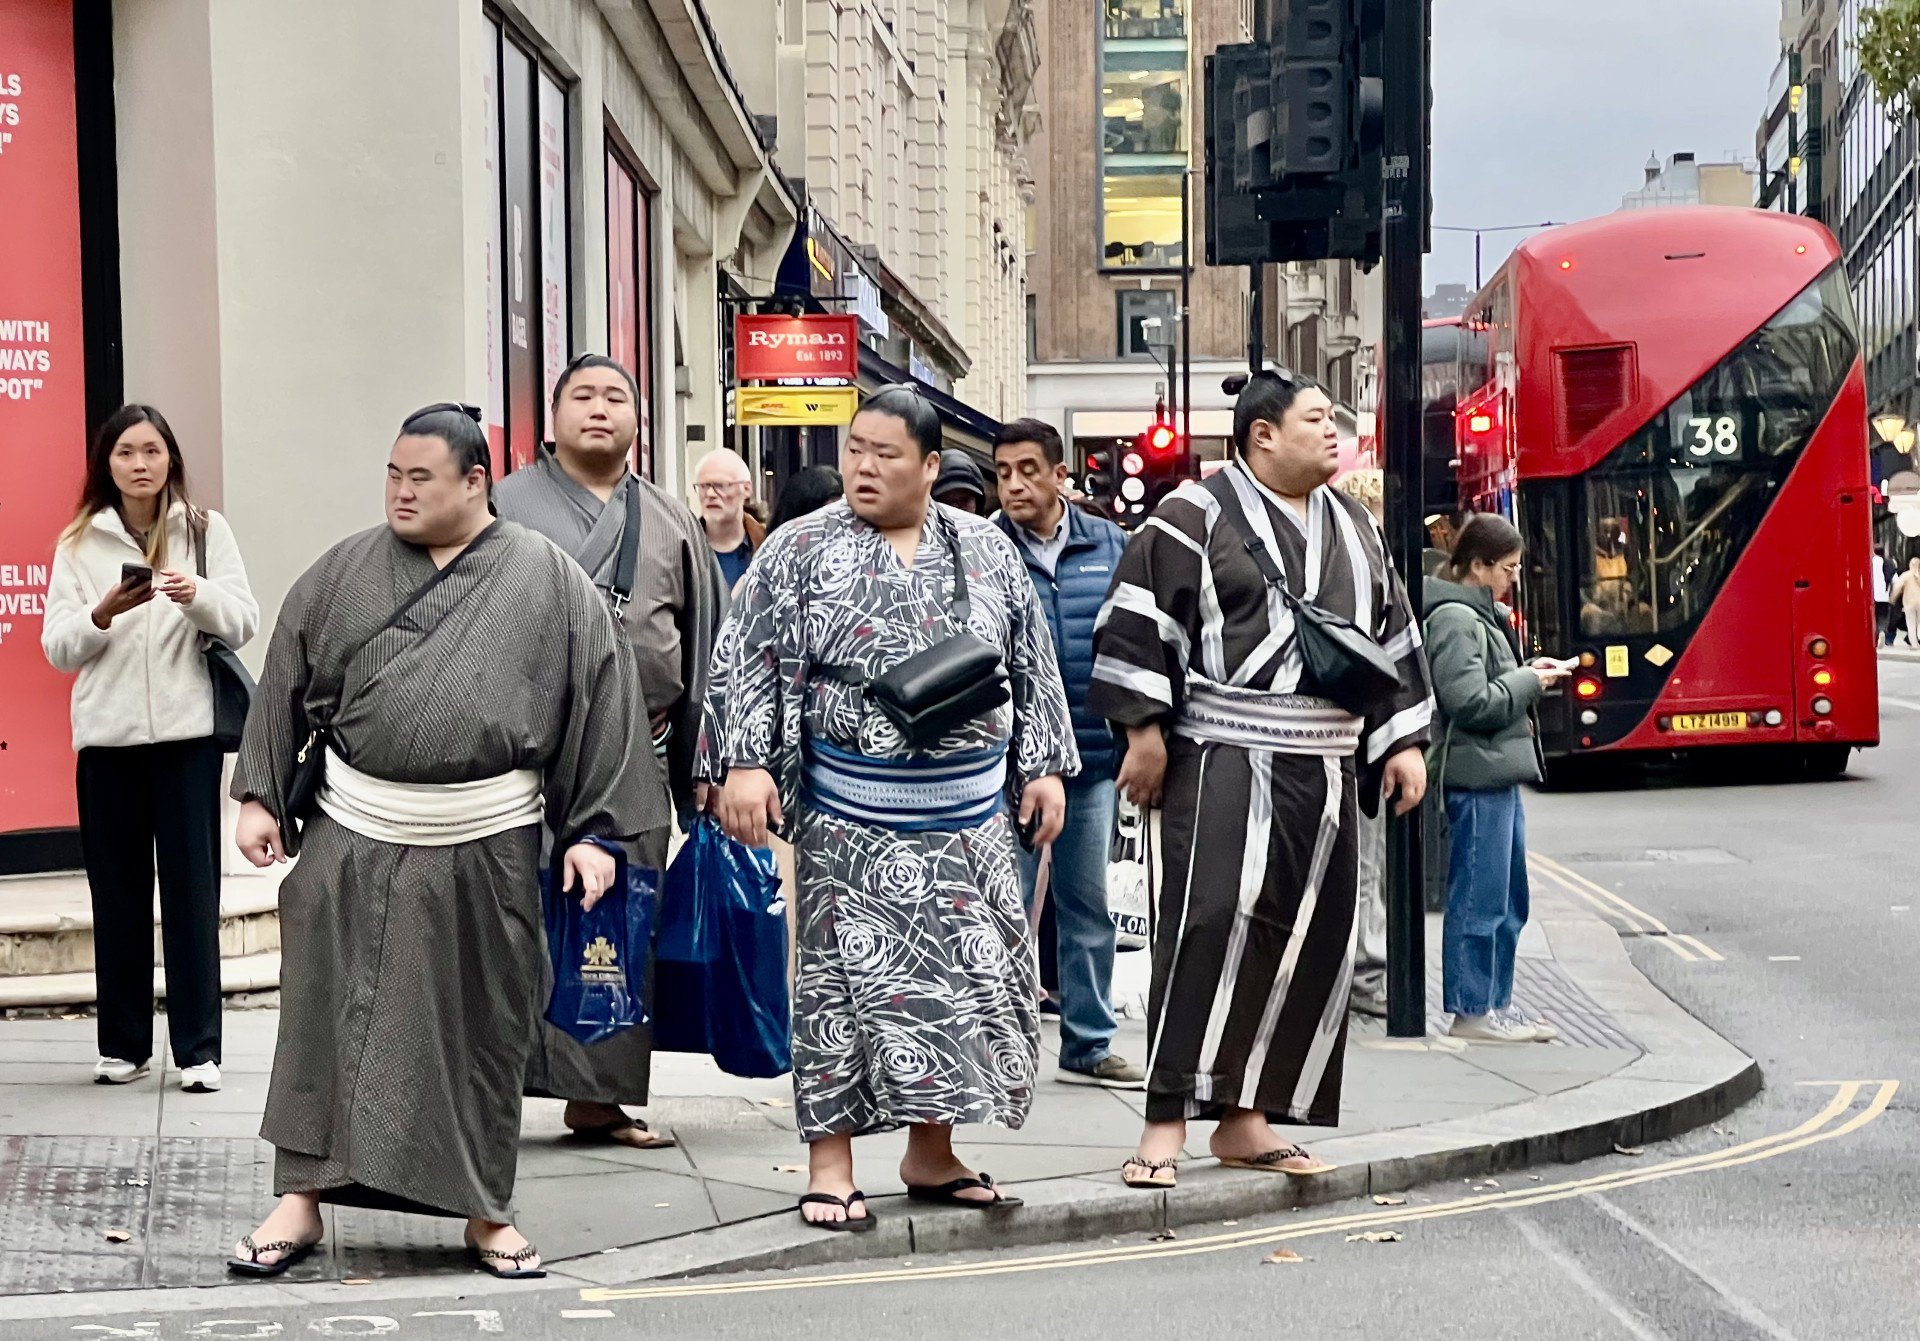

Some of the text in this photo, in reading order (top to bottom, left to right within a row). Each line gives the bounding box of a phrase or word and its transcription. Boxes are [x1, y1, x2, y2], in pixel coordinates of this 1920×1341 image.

[0, 319, 50, 343] WITH
[748, 330, 846, 349] Ryman
[0, 348, 51, 372] WAYS
[795, 350, 843, 362] Est. 1893
[1688, 416, 1738, 457] 38
[26, 564, 47, 586] IN
